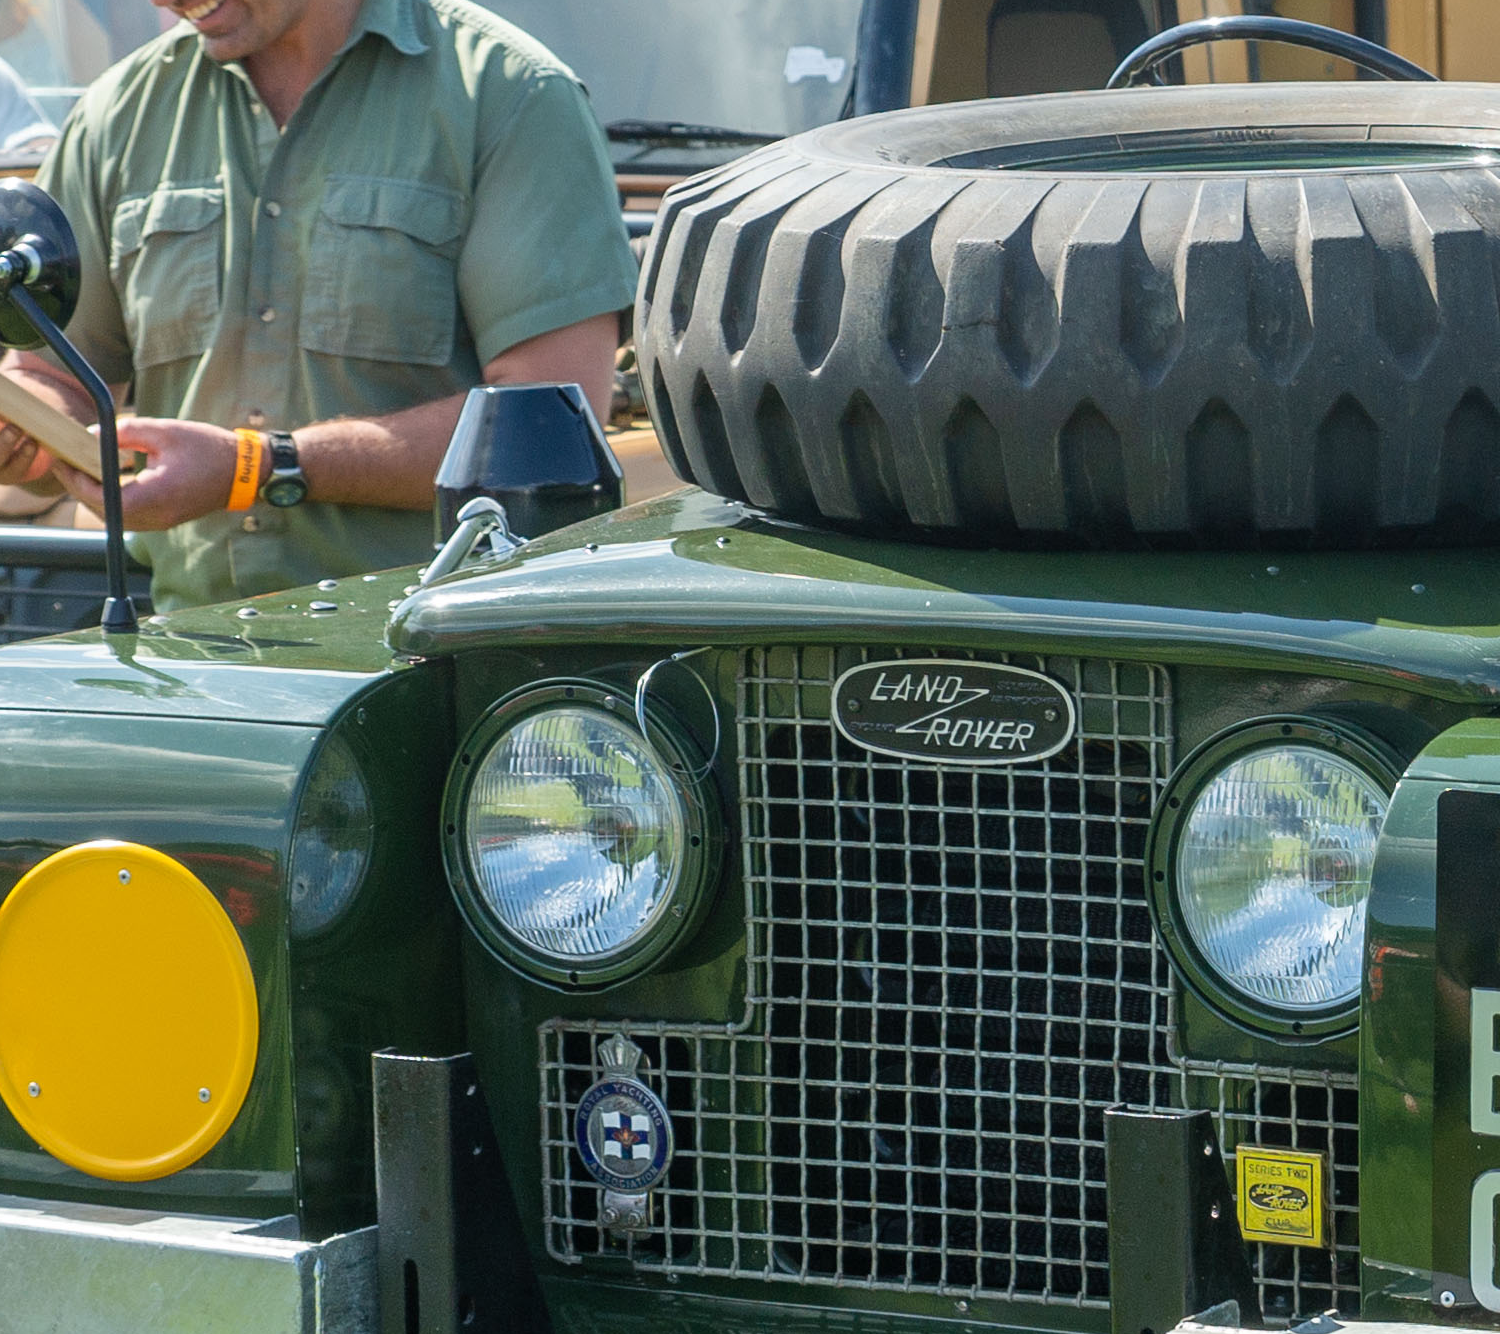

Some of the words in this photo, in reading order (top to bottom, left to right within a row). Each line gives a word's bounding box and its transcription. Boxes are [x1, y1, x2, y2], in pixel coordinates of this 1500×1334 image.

[240, 435, 255, 484] amping
[870, 672, 963, 704] LAND
[923, 717, 1036, 752] ROVER
[579, 1087, 609, 1122] ROYAL
[613, 1083, 663, 1127] YACHTING
[589, 1164, 659, 1190] ASSOCIATION
[1248, 1163, 1283, 1177] SERIES
[1286, 1167, 1309, 1180] TWO
